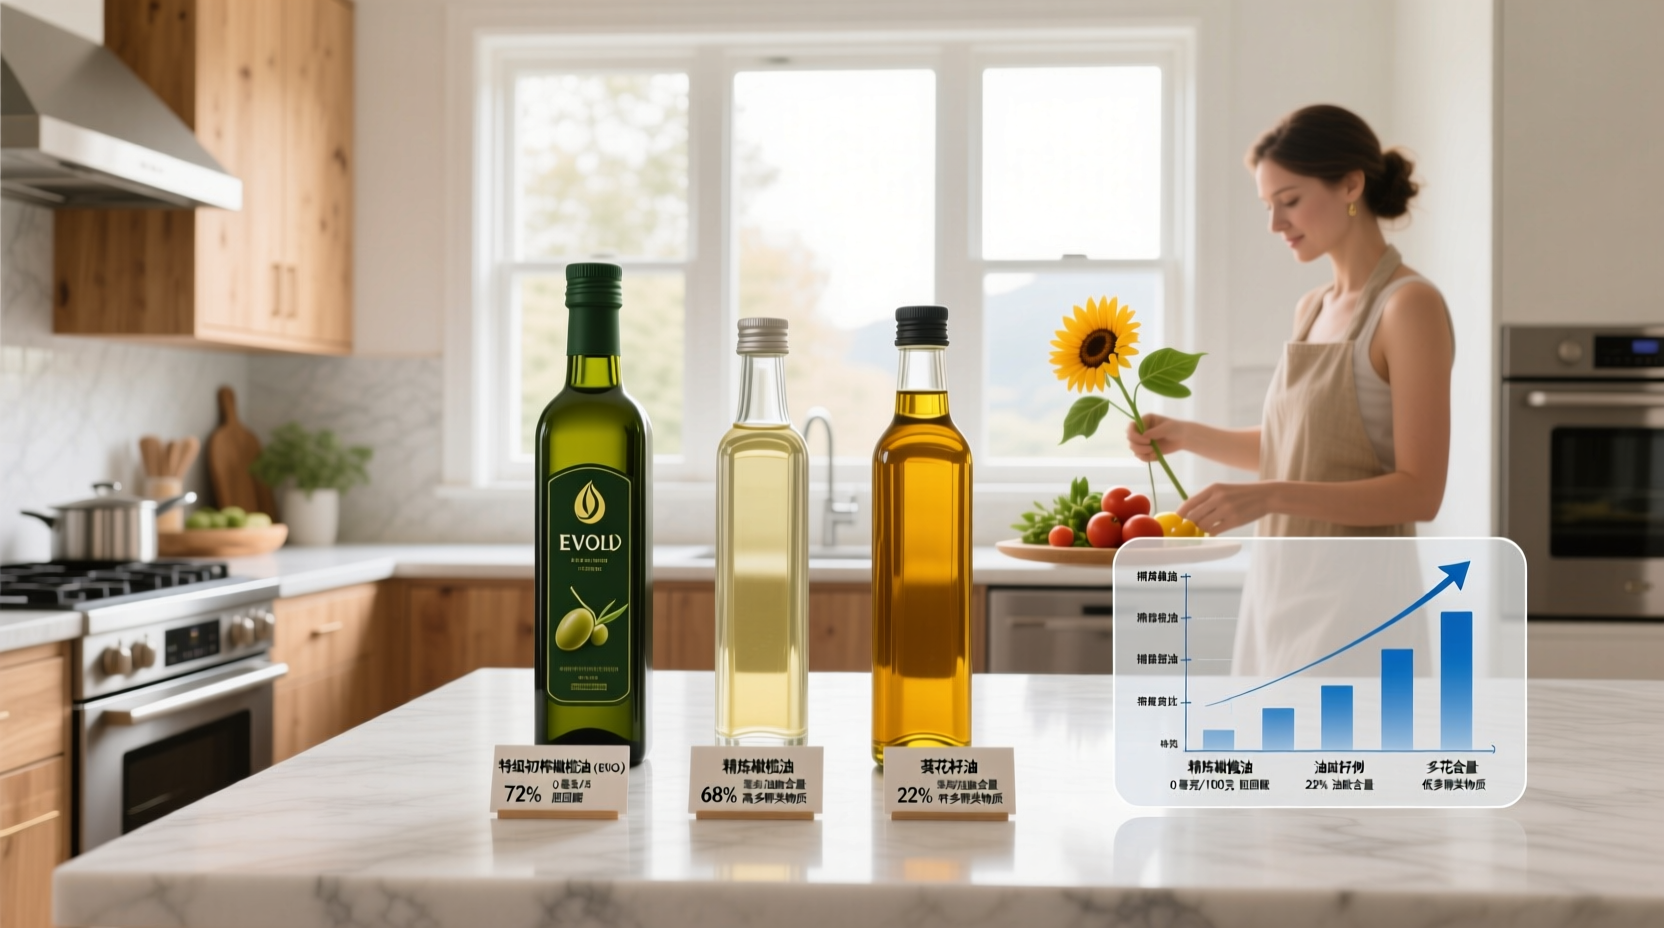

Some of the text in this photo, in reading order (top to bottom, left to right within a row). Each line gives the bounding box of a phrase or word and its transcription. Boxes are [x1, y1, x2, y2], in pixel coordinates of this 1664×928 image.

[504, 784, 542, 803] 72%
[701, 786, 738, 803] 68%
[898, 786, 933, 804] 22%
